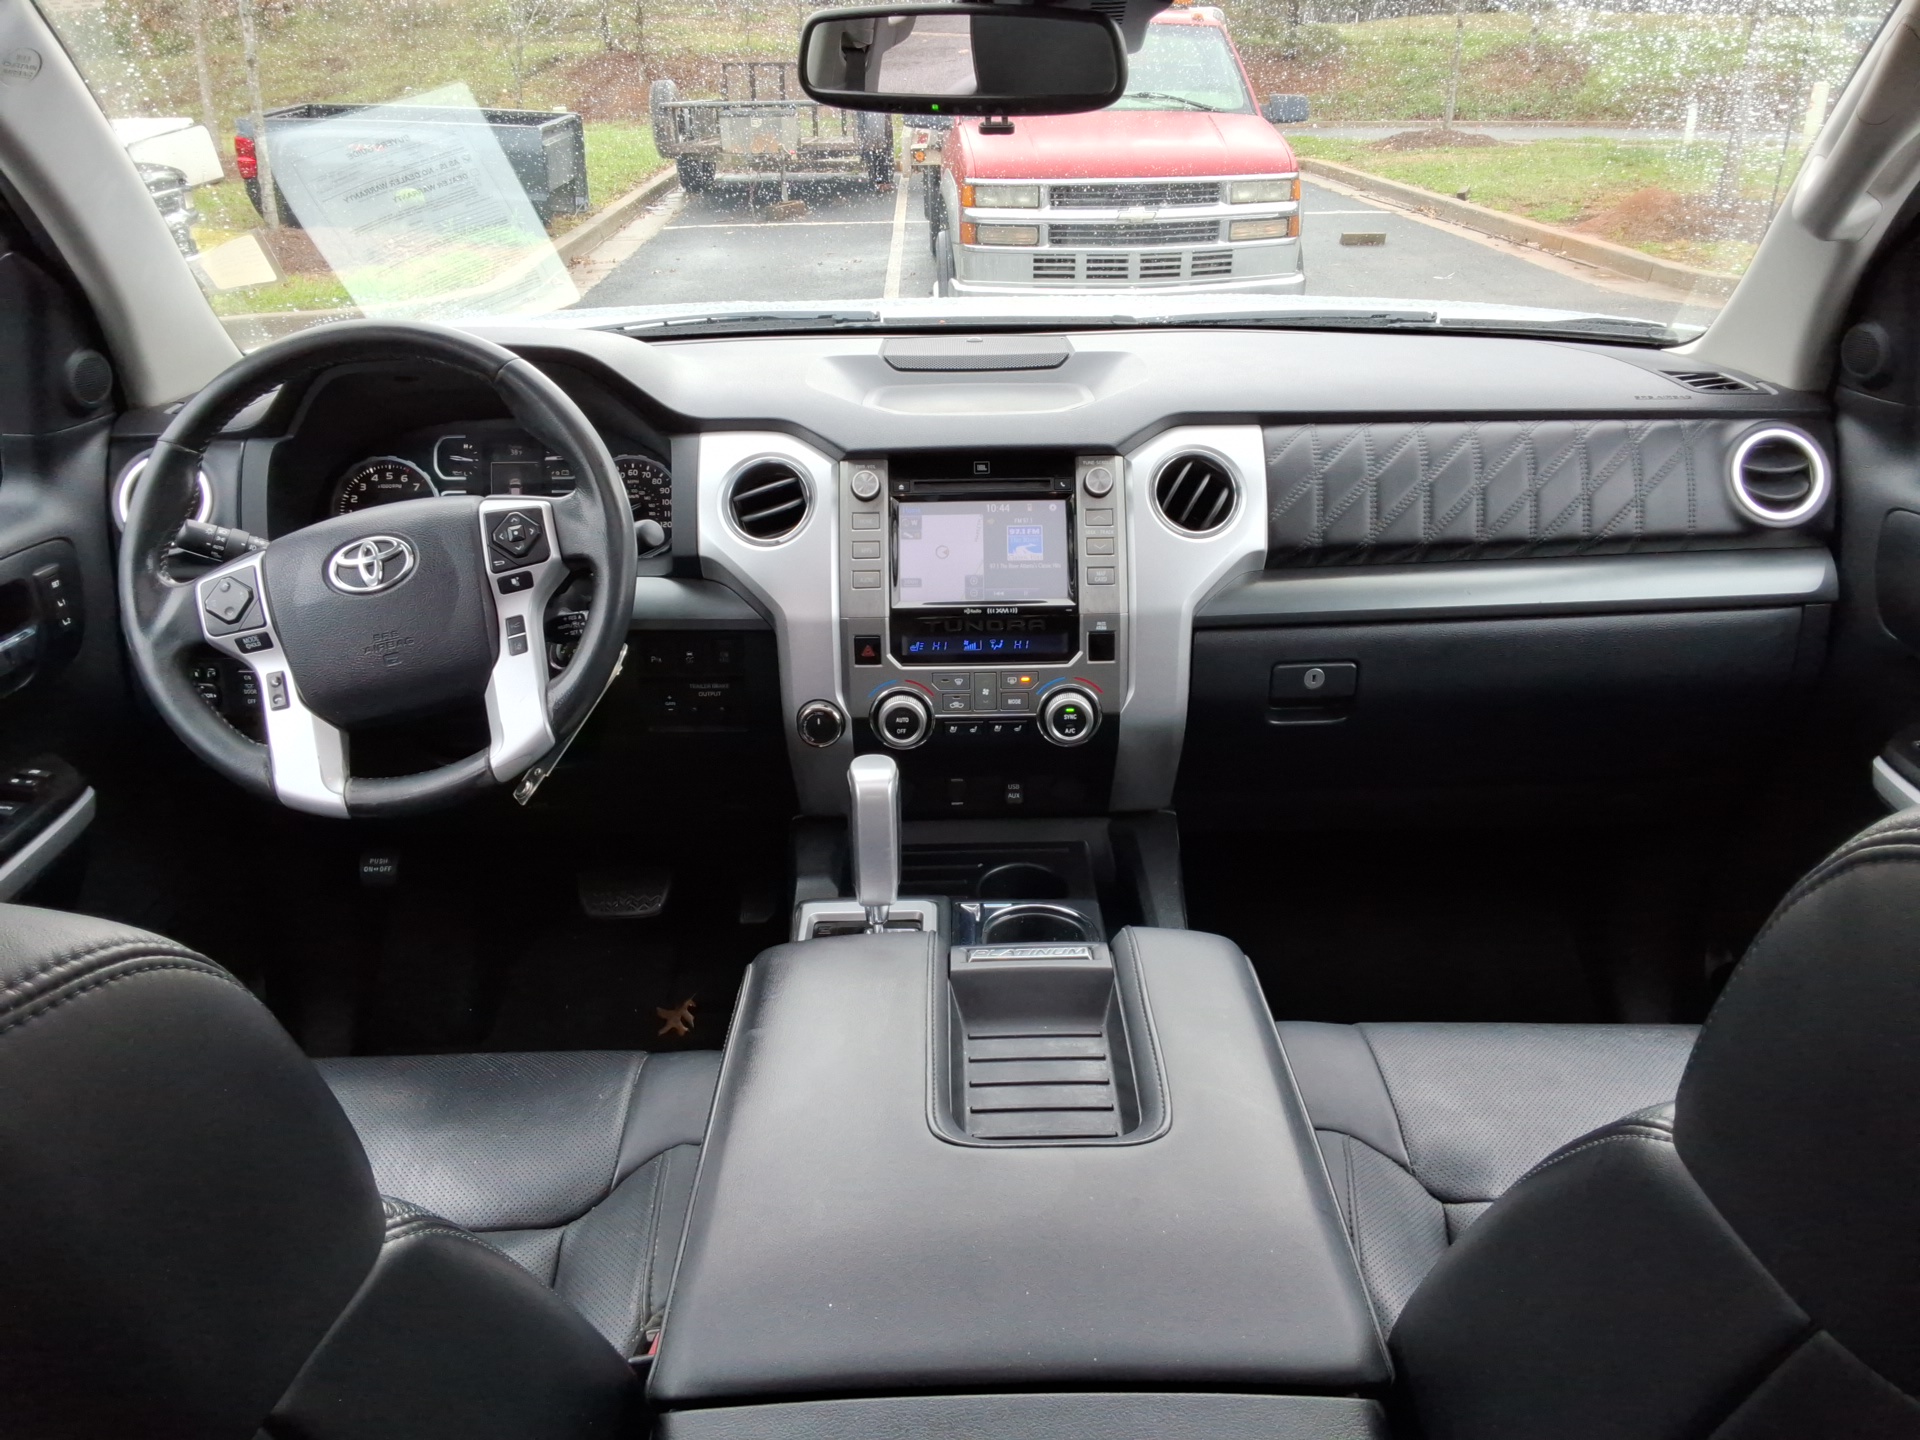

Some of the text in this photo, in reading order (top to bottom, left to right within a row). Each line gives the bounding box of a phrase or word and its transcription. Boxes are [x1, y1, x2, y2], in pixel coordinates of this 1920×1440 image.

[371, 474, 379, 482] 4
[386, 472, 394, 480] 5
[400, 474, 408, 482] 6
[360, 483, 367, 491] 3
[413, 483, 420, 491] 7
[350, 495, 358, 503] 2
[986, 503, 1010, 513] 10:44
[922, 619, 1046, 632] TUNDRA
[364, 636, 415, 655] AIRBAG
[932, 641, 948, 651] HI
[1013, 640, 1030, 649] HI
[369, 857, 389, 865] PUSH
[972, 947, 1087, 957] PLATINUM
